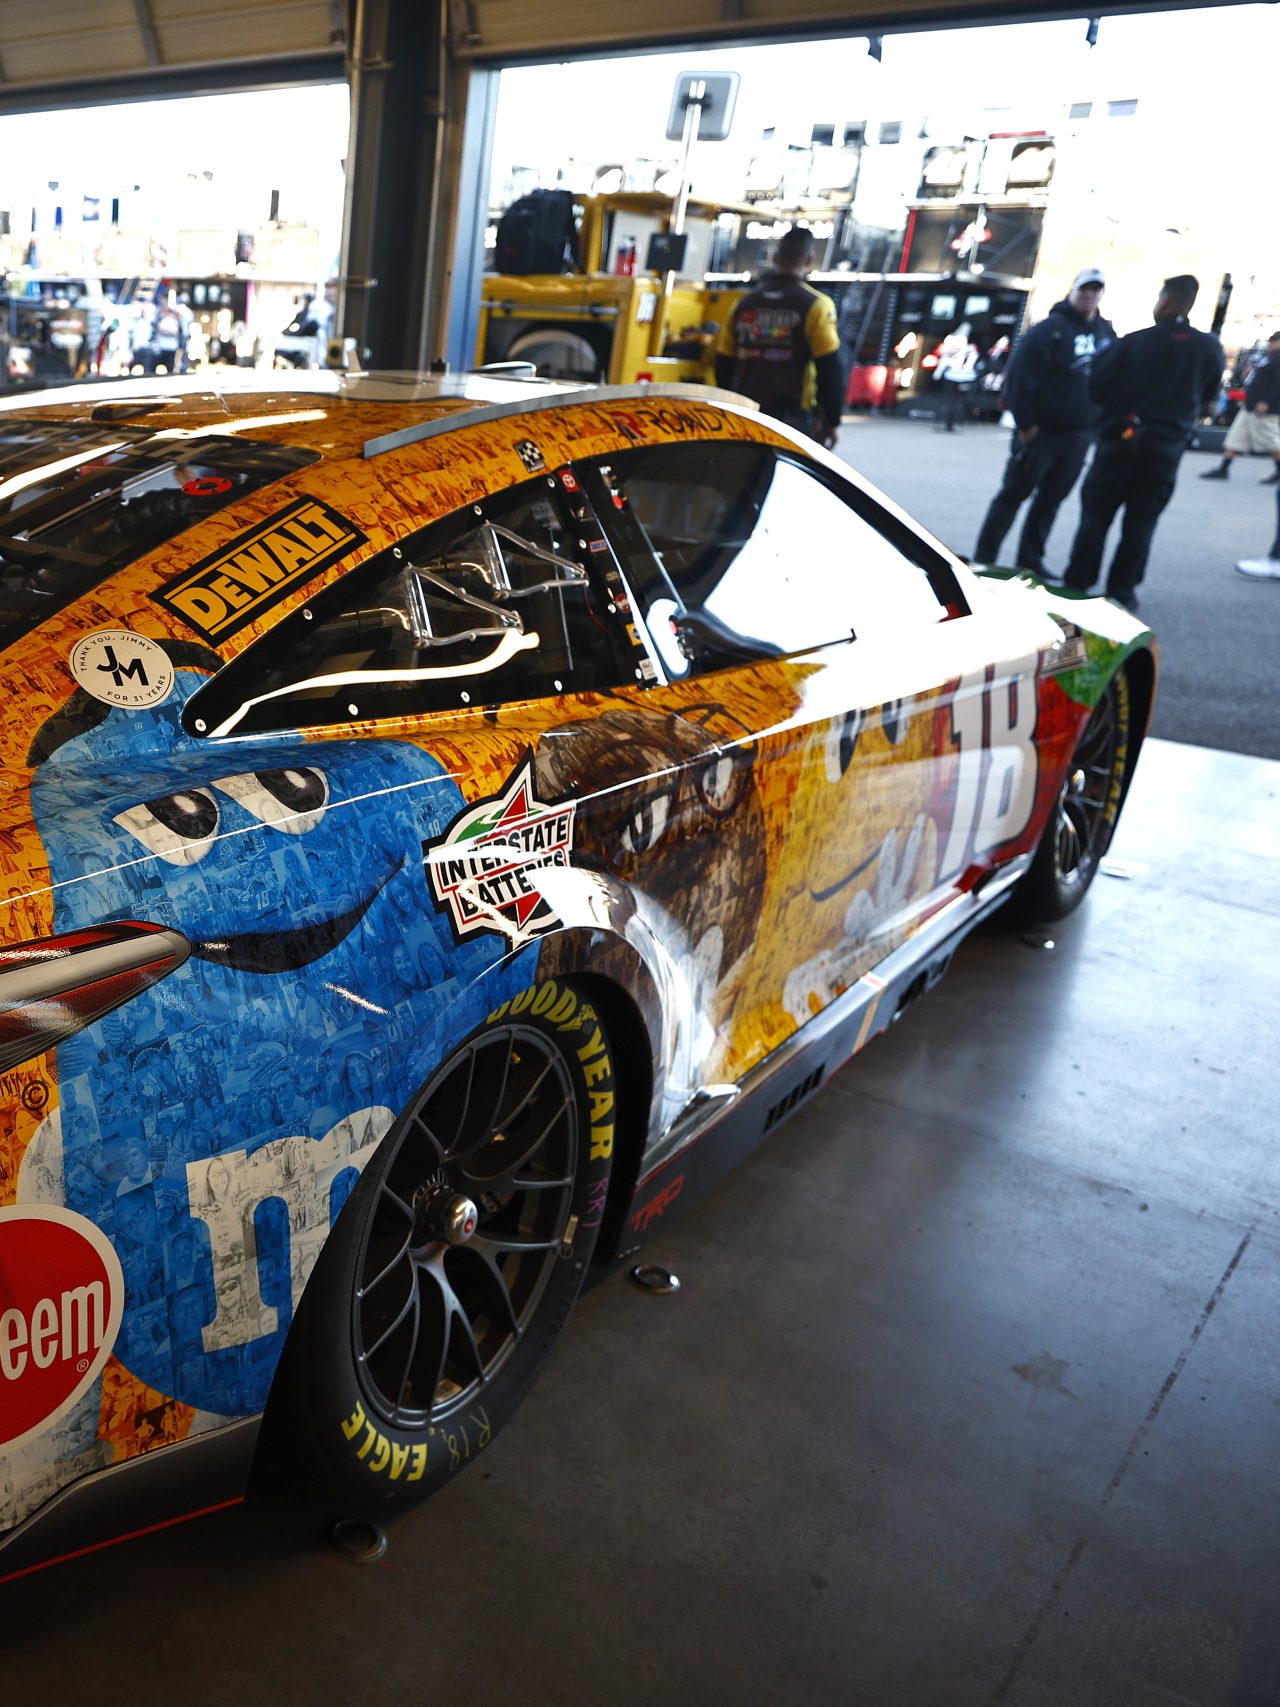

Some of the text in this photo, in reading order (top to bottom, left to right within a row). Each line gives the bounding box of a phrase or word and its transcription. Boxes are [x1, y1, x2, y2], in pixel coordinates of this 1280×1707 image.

[638, 408, 737, 434] ROWDY
[80, 646, 91, 672] THANK
[121, 636, 152, 651] JIMMY
[96, 645, 149, 687] JM
[107, 691, 128, 702] FOR
[146, 675, 166, 698] YEARS
[938, 664, 1037, 881] 18
[340, 1401, 429, 1482] EAGLE
